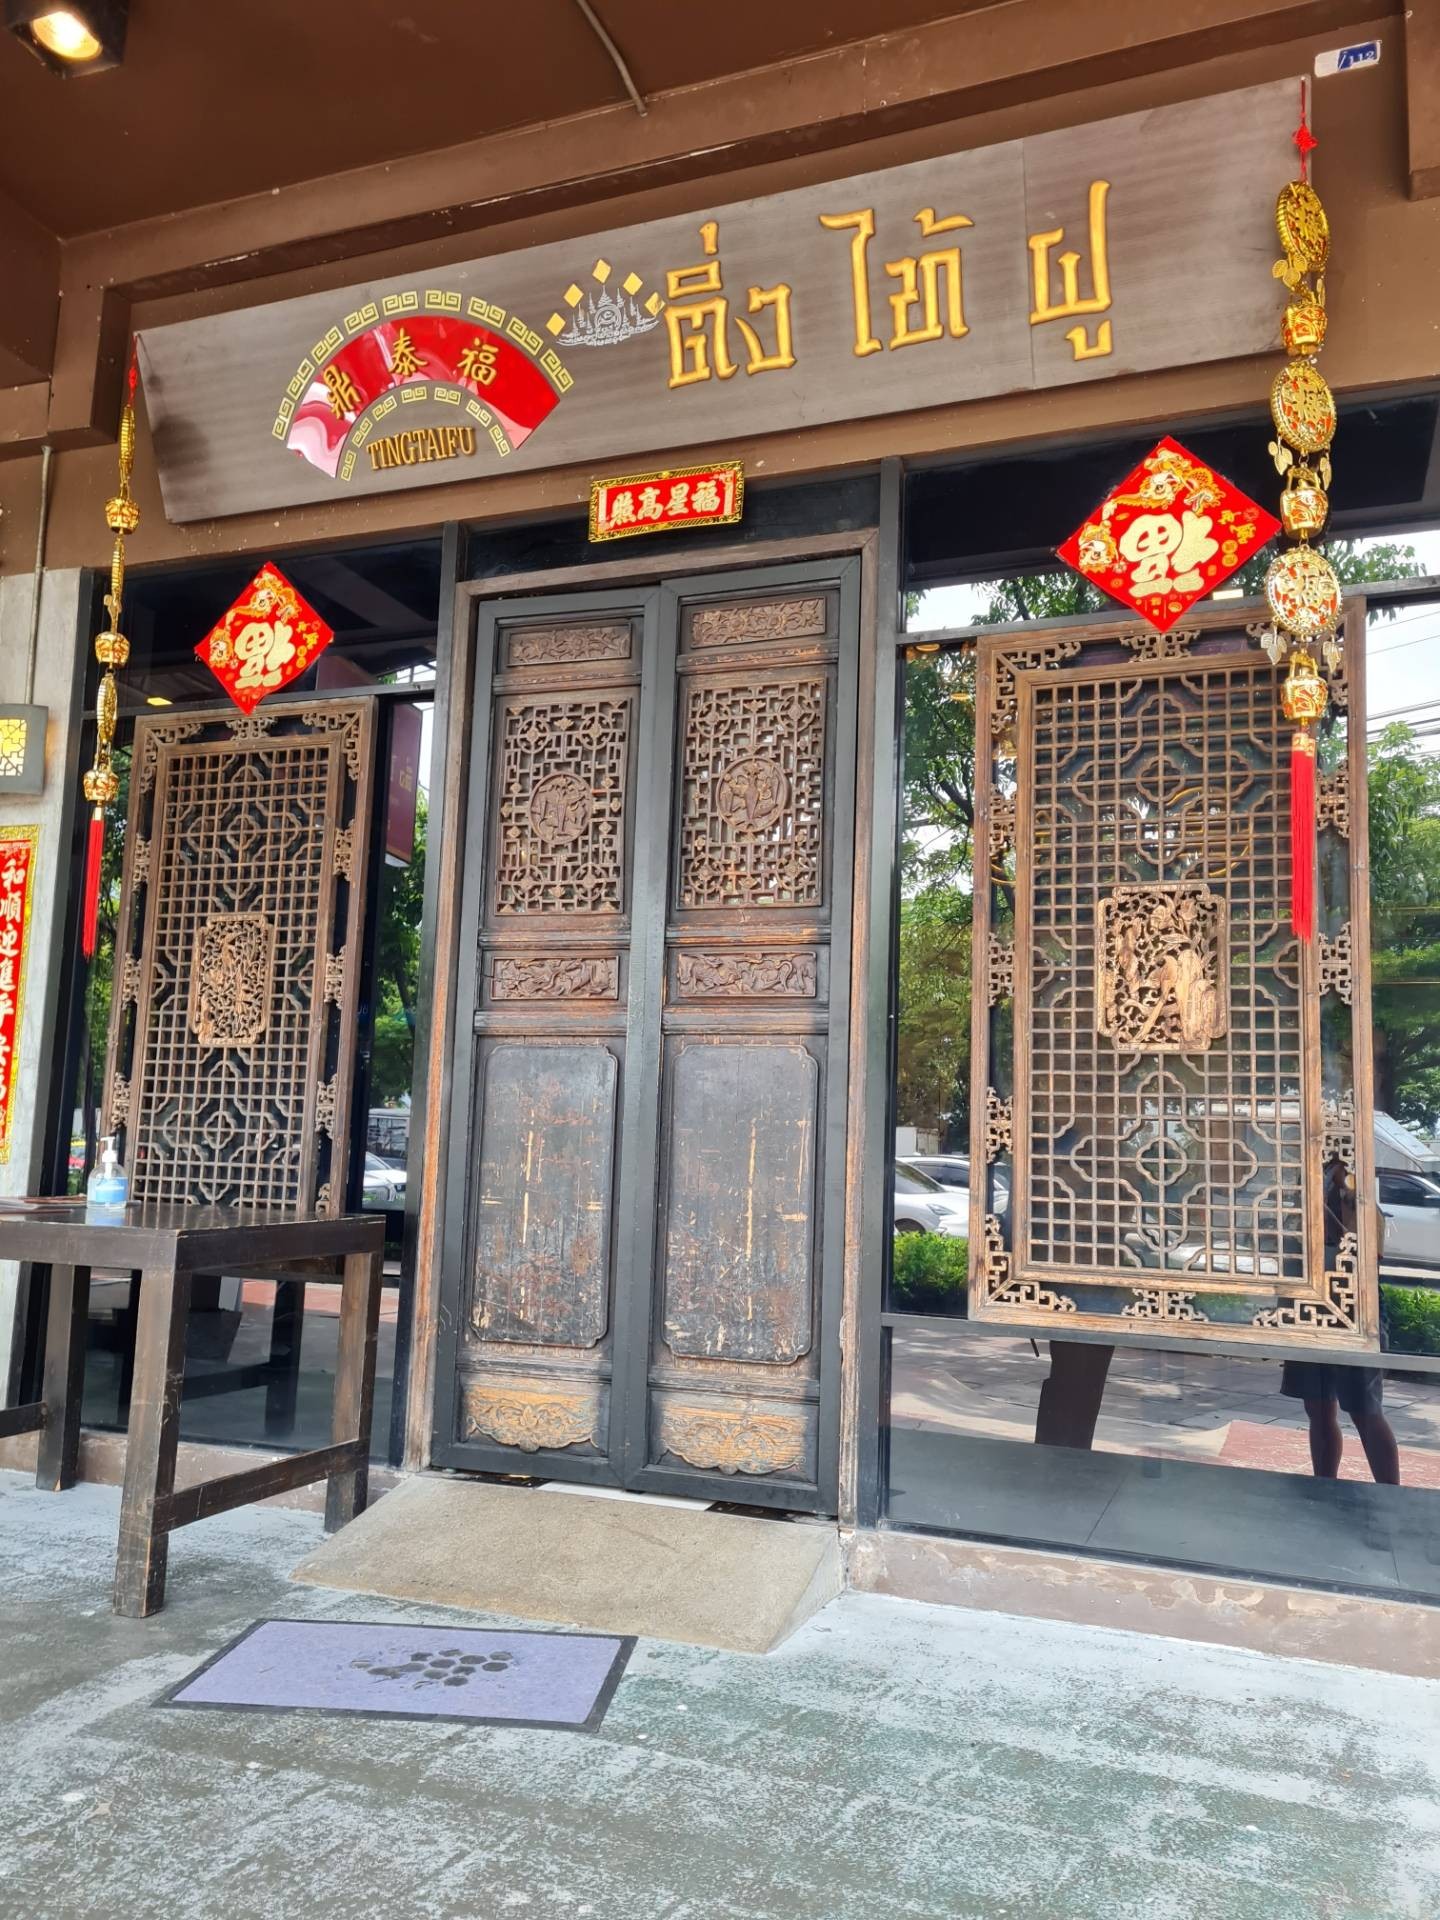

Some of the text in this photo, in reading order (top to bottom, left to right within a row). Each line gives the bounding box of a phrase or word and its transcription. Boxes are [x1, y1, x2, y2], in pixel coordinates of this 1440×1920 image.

[366, 426, 475, 470] TINGTAIFU
[1119, 510, 1219, 597] 福
[235, 621, 296, 689] 福
